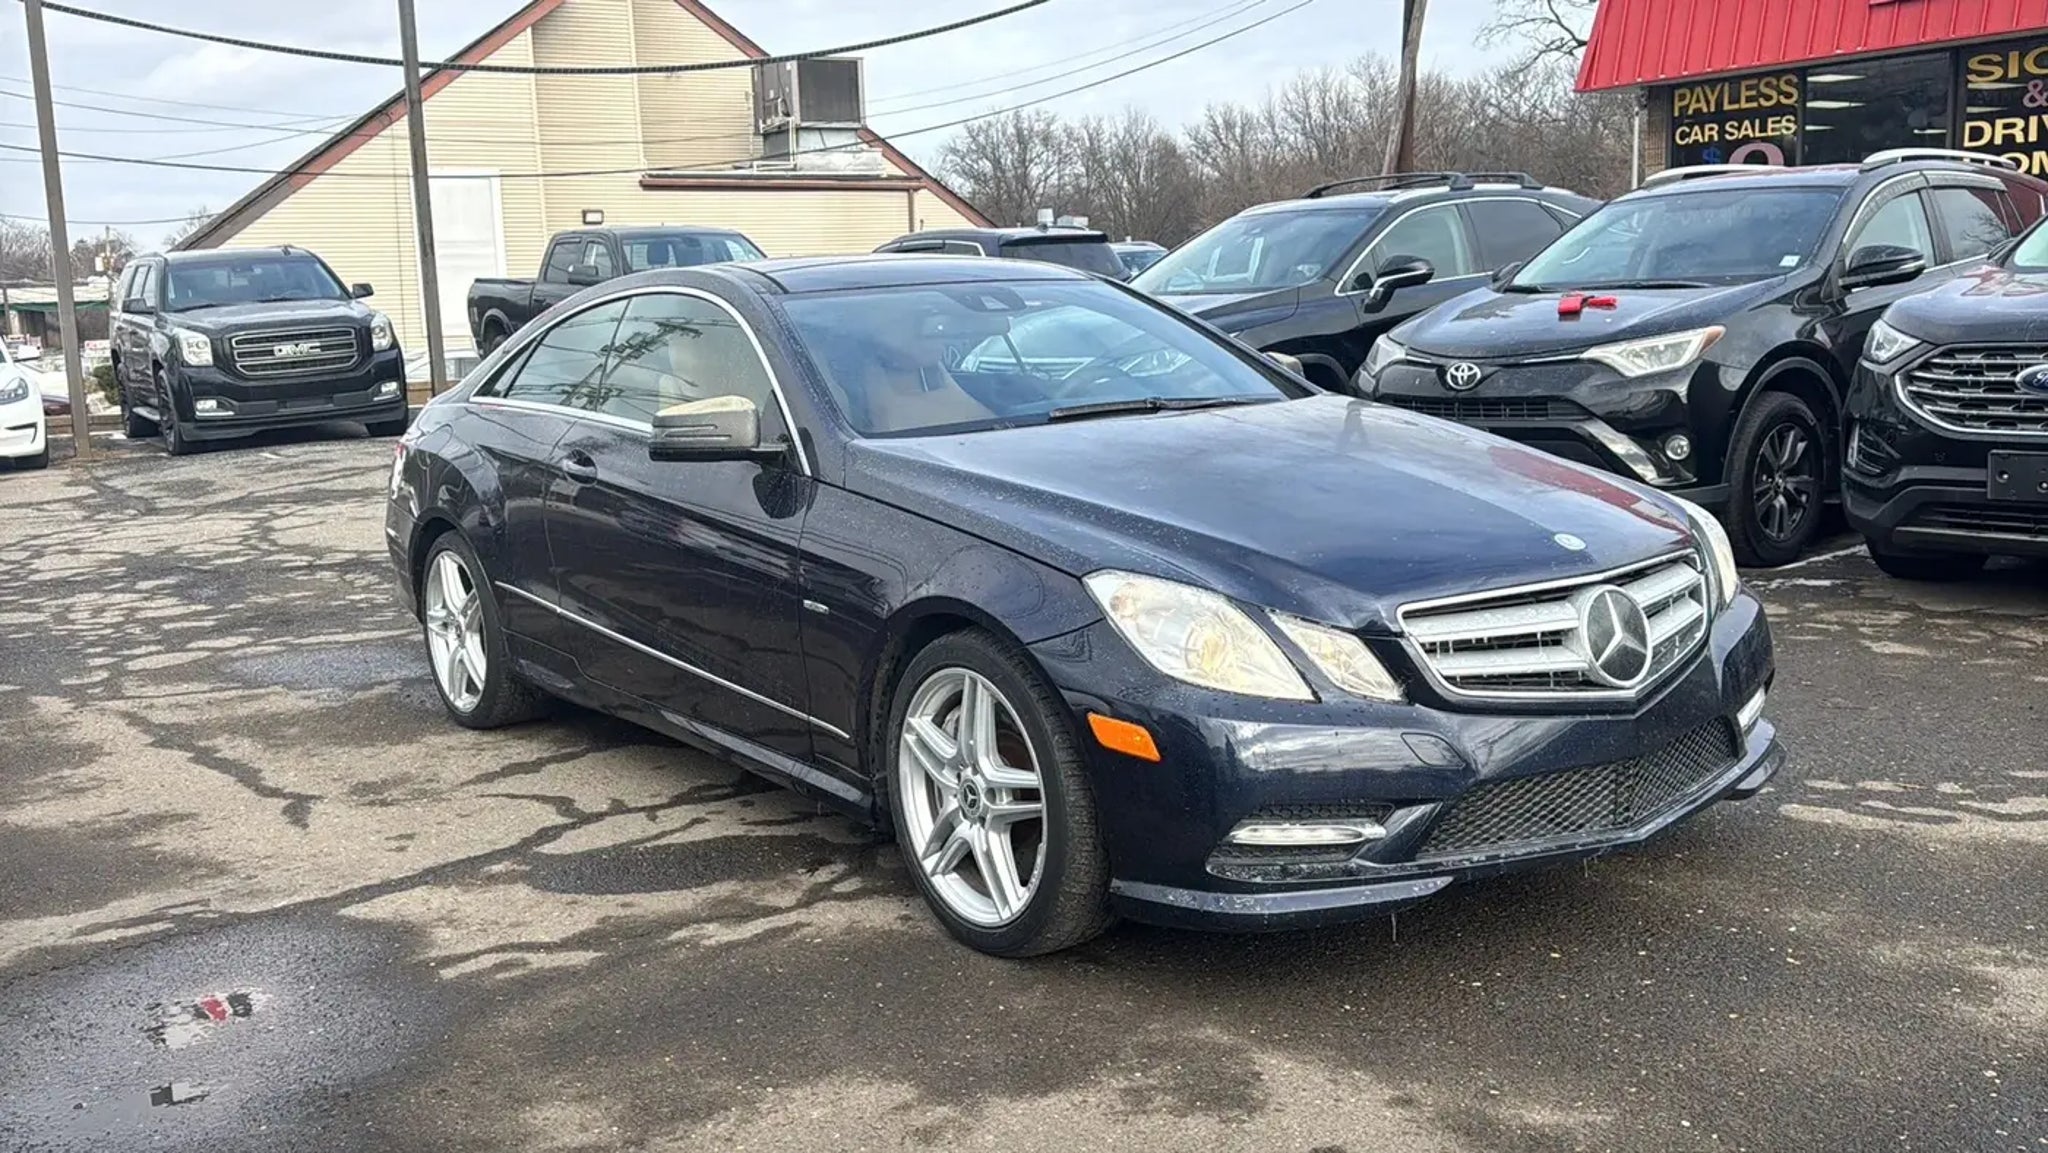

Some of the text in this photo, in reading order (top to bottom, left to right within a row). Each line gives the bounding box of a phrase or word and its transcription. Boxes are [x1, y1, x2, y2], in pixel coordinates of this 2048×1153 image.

[1673, 74, 1799, 117] PAYLESS
[1675, 115, 1797, 146] CAR SALES
[1963, 114, 2048, 148] DRI
[273, 342, 321, 357] GMC
